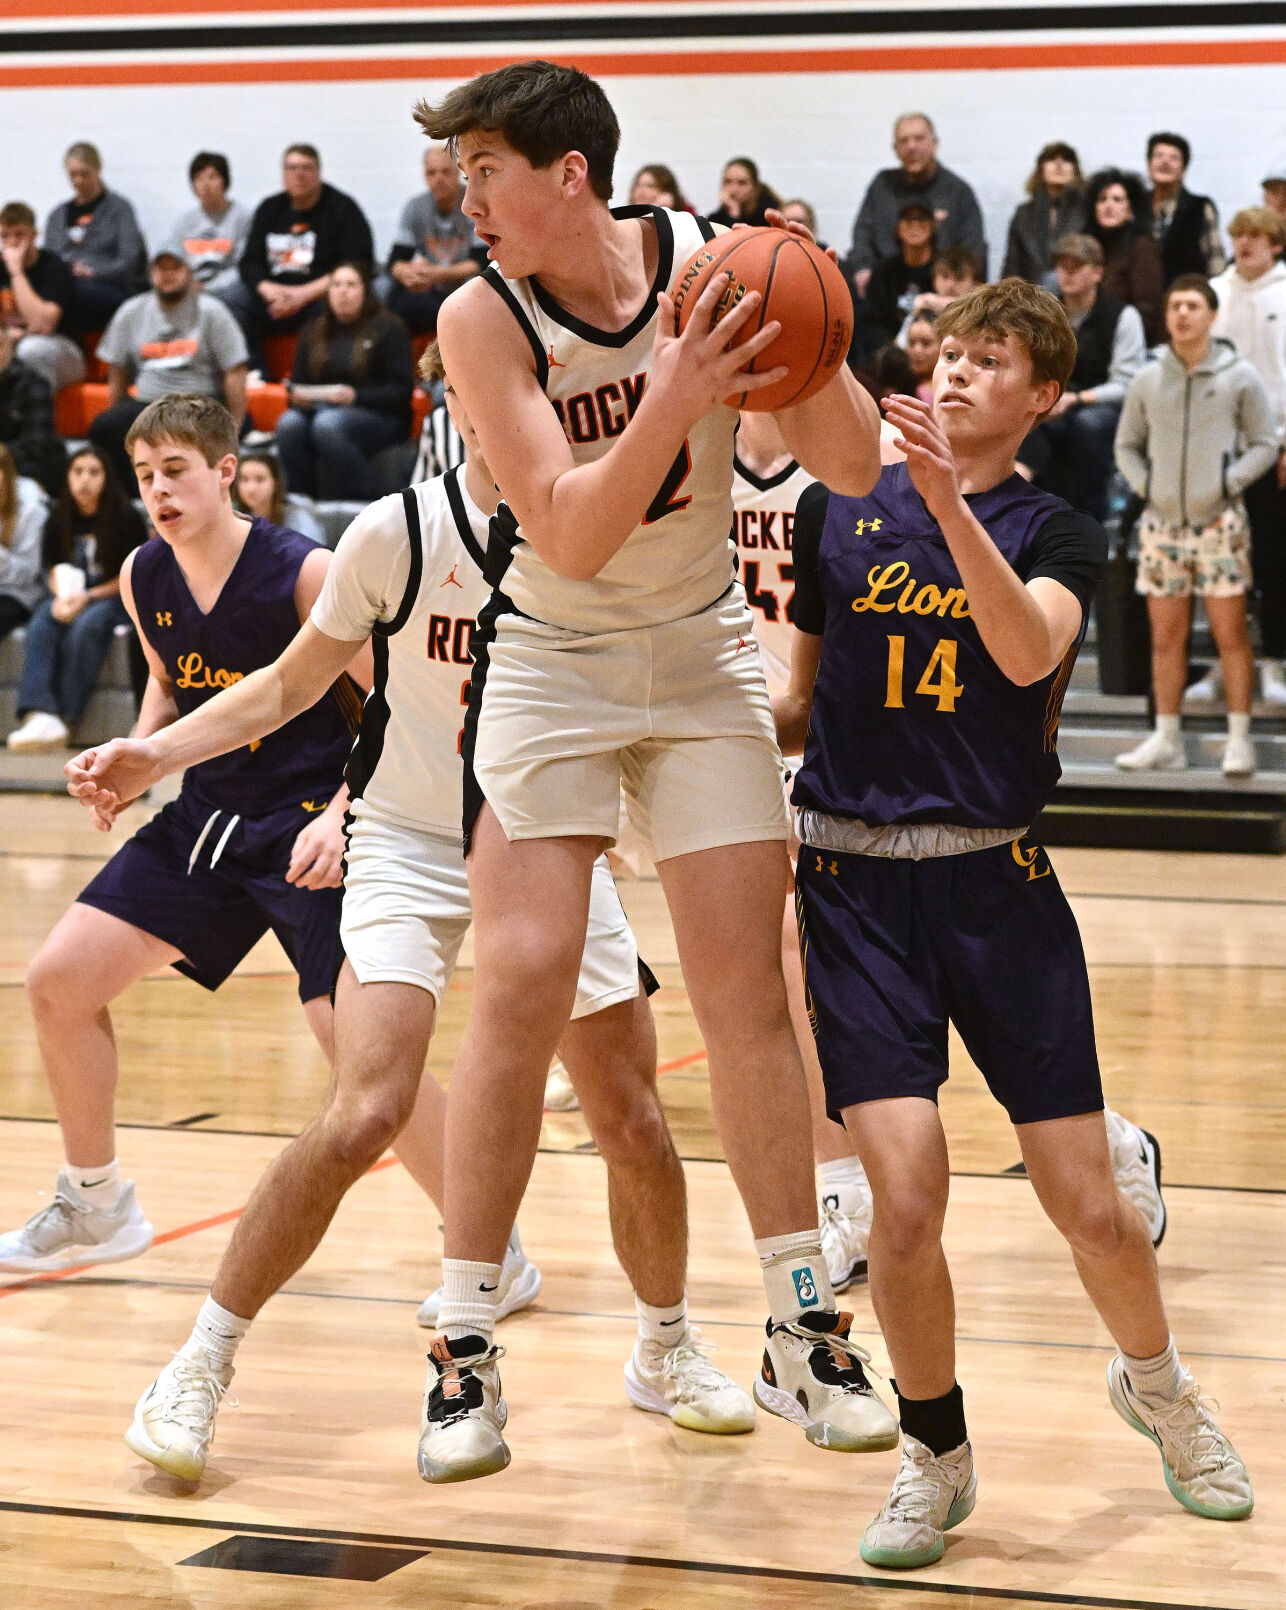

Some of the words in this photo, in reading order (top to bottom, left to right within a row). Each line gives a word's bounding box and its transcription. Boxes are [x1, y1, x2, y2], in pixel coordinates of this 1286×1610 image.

[851, 561, 972, 619] Lion
[427, 613, 477, 665] RO
[883, 634, 964, 713] 14
